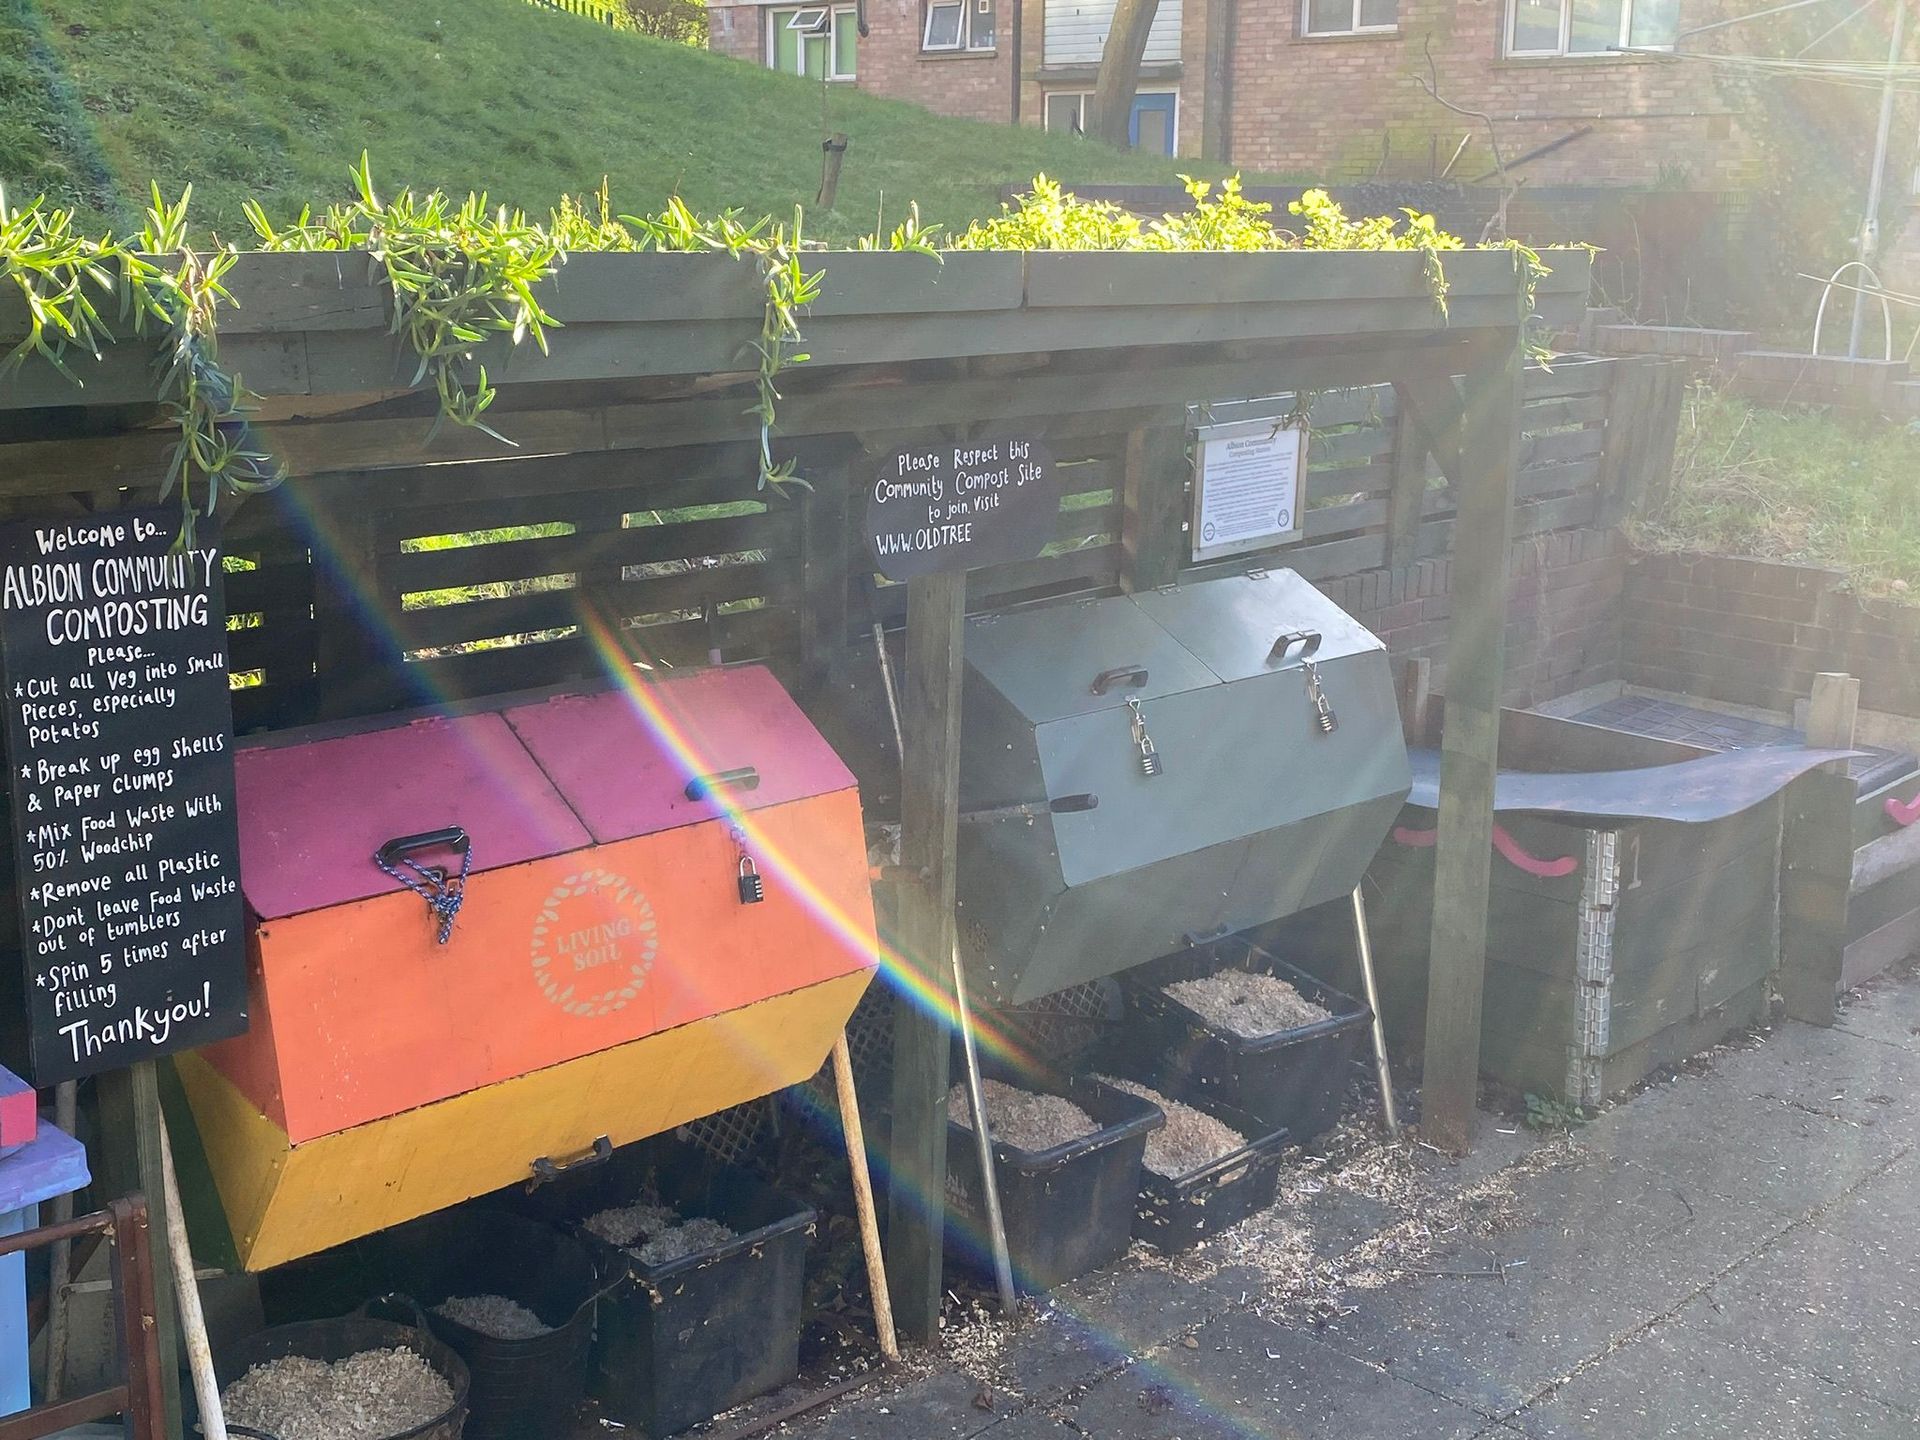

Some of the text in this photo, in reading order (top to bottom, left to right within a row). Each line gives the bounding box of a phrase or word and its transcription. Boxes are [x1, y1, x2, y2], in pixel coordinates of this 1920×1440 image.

[899, 441, 1030, 476] Please Respect this
[875, 475, 943, 503] Community
[956, 467, 1009, 495] Compost
[929, 506, 940, 523] to
[3, 561, 84, 610] ALBION
[46, 594, 208, 645] COMPOSTING
[70, 673, 94, 690] all
[145, 662, 177, 682] into
[93, 687, 175, 713] especially
[134, 747, 160, 767] egg
[27, 794, 42, 812] &
[32, 849, 68, 871] 50%
[125, 865, 148, 883] all
[97, 897, 139, 921] leave
[37, 910, 180, 955] out of tumblers
[556, 918, 630, 954] LIVING
[100, 953, 112, 974] 5
[123, 939, 169, 967] times
[182, 929, 227, 956] after
